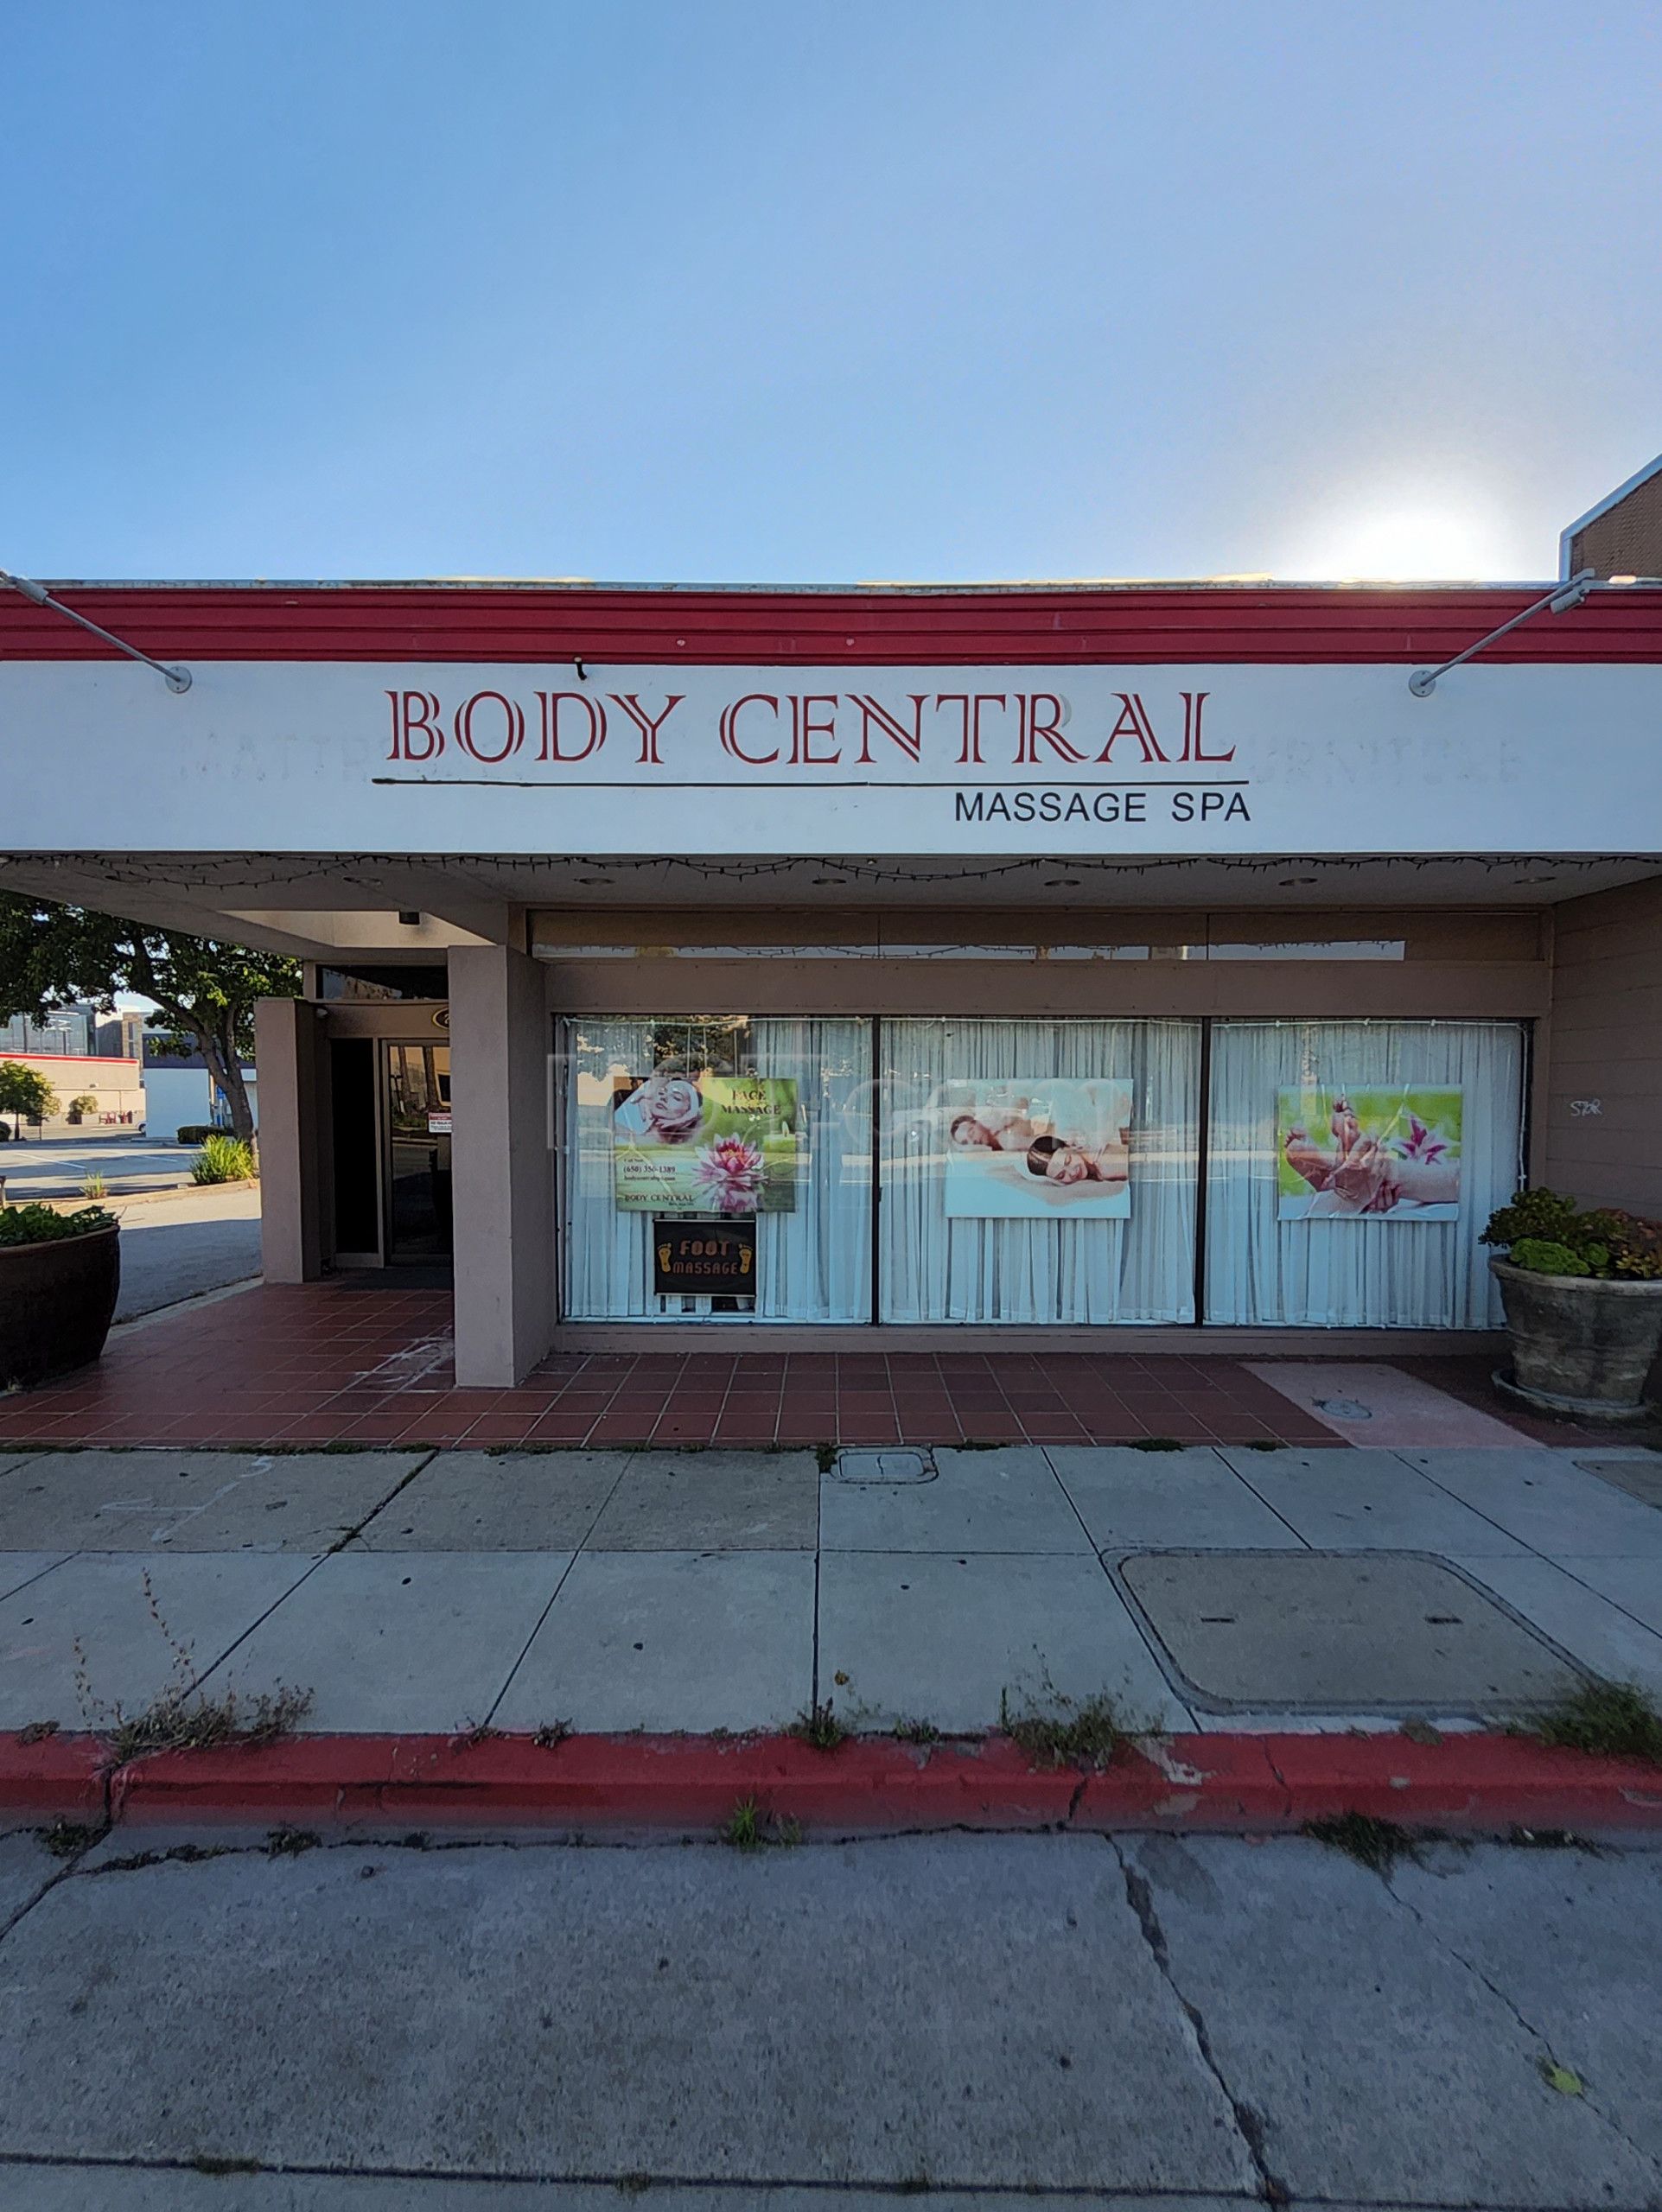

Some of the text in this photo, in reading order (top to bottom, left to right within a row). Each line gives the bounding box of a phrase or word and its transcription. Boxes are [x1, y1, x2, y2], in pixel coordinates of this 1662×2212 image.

[385, 690, 1236, 765] BODY CENTRAL
[955, 791, 1251, 823] MASSAGE SPA
[732, 1090, 767, 1101] FACE
[721, 1104, 781, 1115] MASSAGE
[650, 1194, 693, 1203] CENTRAL
[679, 1240, 730, 1256] FOOT
[672, 1262, 738, 1274] MASSAGE
